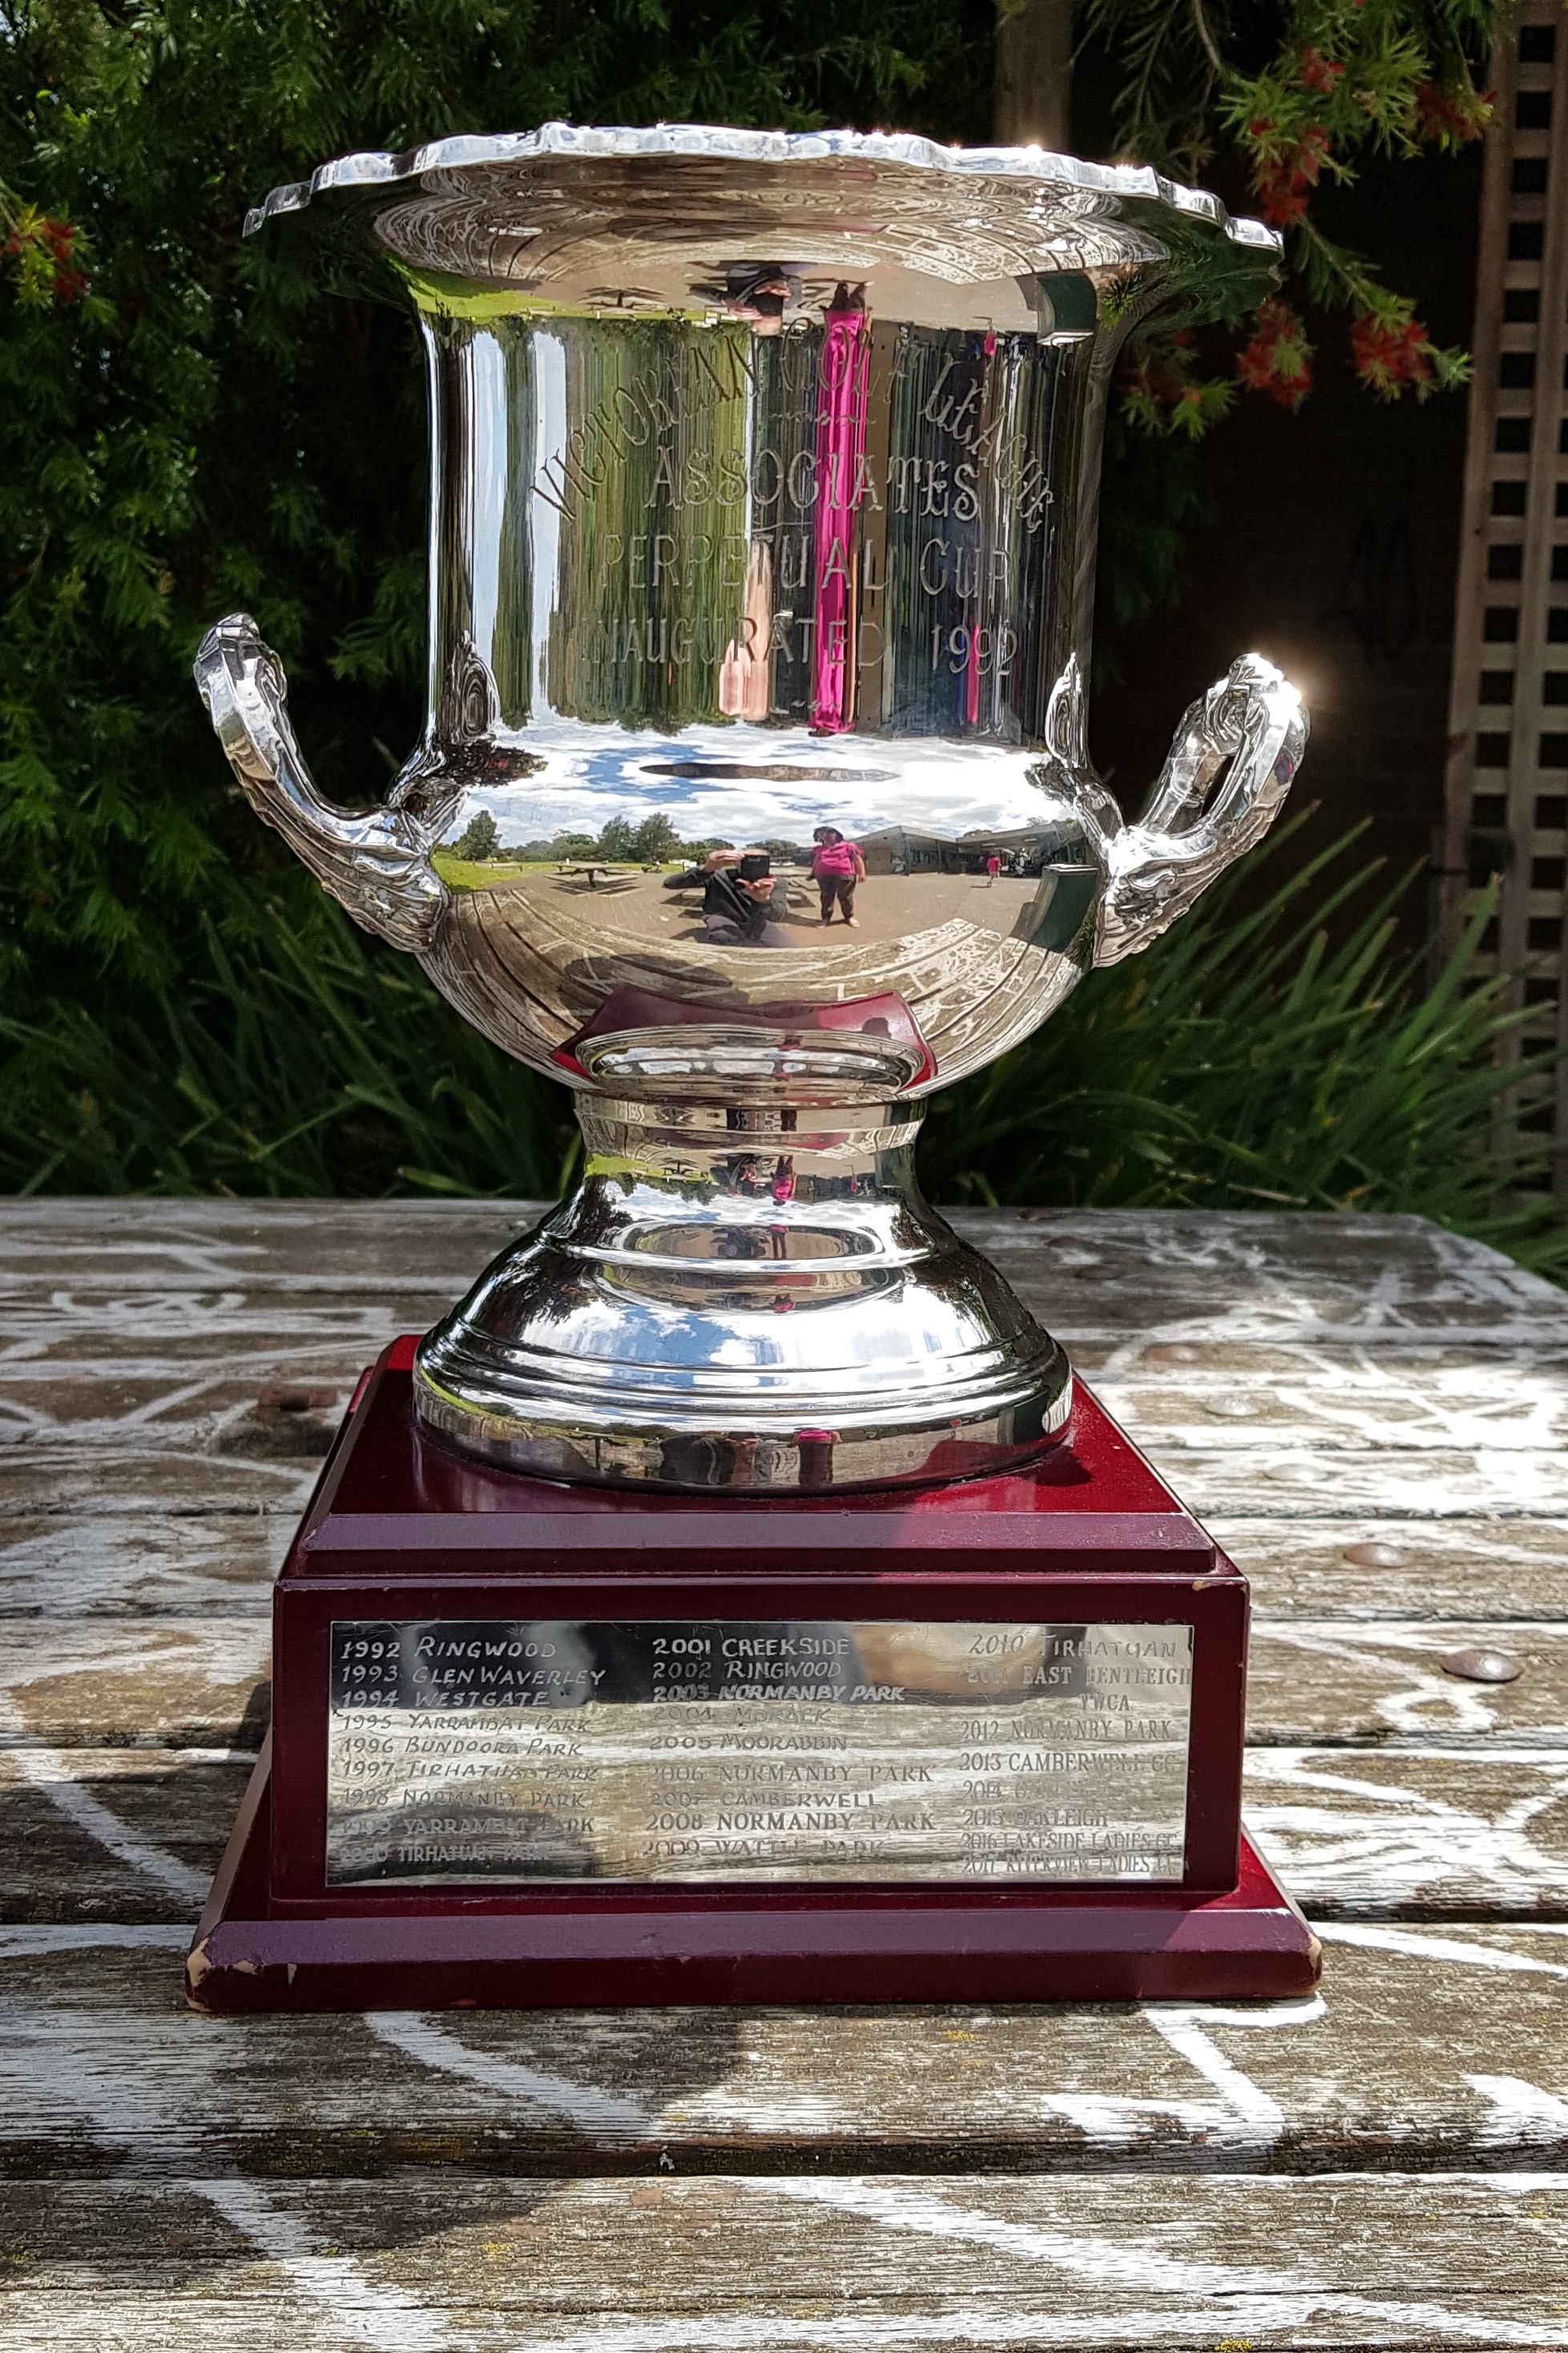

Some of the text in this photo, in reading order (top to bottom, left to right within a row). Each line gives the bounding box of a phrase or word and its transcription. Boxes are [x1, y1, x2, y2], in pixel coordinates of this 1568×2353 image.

[529, 334, 760, 525] VICTORIAN
[643, 446, 980, 522] ASSOCIATES
[602, 534, 1011, 599] PERPETUAL CUP
[581, 616, 1018, 676] INAUGURATED 1992
[341, 1636, 558, 1659] 1992 RINGWOOD
[652, 1637, 850, 1657] 2001 CREEKSIDE
[968, 1634, 1025, 1655] 2010
[341, 1665, 607, 1685] 1993 GLEN WAVERLEY
[653, 1661, 842, 1679] 2002 RINGWOOD
[1022, 1665, 1073, 1685] EAST
[341, 1689, 550, 1708] 1994 WESTGATE
[653, 1685, 906, 1702] 2003 NORMANBY PARK
[1078, 1693, 1131, 1711] YWCA
[342, 1713, 591, 1733] 1995 YARRAMBAT PARK
[653, 1706, 715, 1723] 2004
[961, 1720, 1172, 1740] 2012 NORMANBY PARK
[342, 1736, 583, 1756] 1996 BUNDOORA PARK
[649, 1734, 848, 1750] 2005 MOORABBIN
[343, 1761, 599, 1781] 1997 TIRHATUAN PARK
[960, 1753, 1002, 1771] 2013
[1008, 1753, 1145, 1771] CAMBERWELL
[647, 1765, 935, 1782] 2006 NORMANBY PARK
[343, 1788, 586, 1808] 1998 NORMANBY PARK
[650, 1792, 884, 1807] 2007 CAMBERWELL
[645, 1813, 938, 1830] 2008 NORMANBY PARK
[962, 1809, 1109, 1826] 2015 OAKLEIGH
[643, 1840, 888, 1856] 2009 WATTLE PARK
[961, 1833, 998, 1849] 2016
[1004, 1833, 1085, 1849] LAKESIDE
[1091, 1833, 1149, 1849] LADIES
[1098, 1855, 1150, 1873] LADIES
